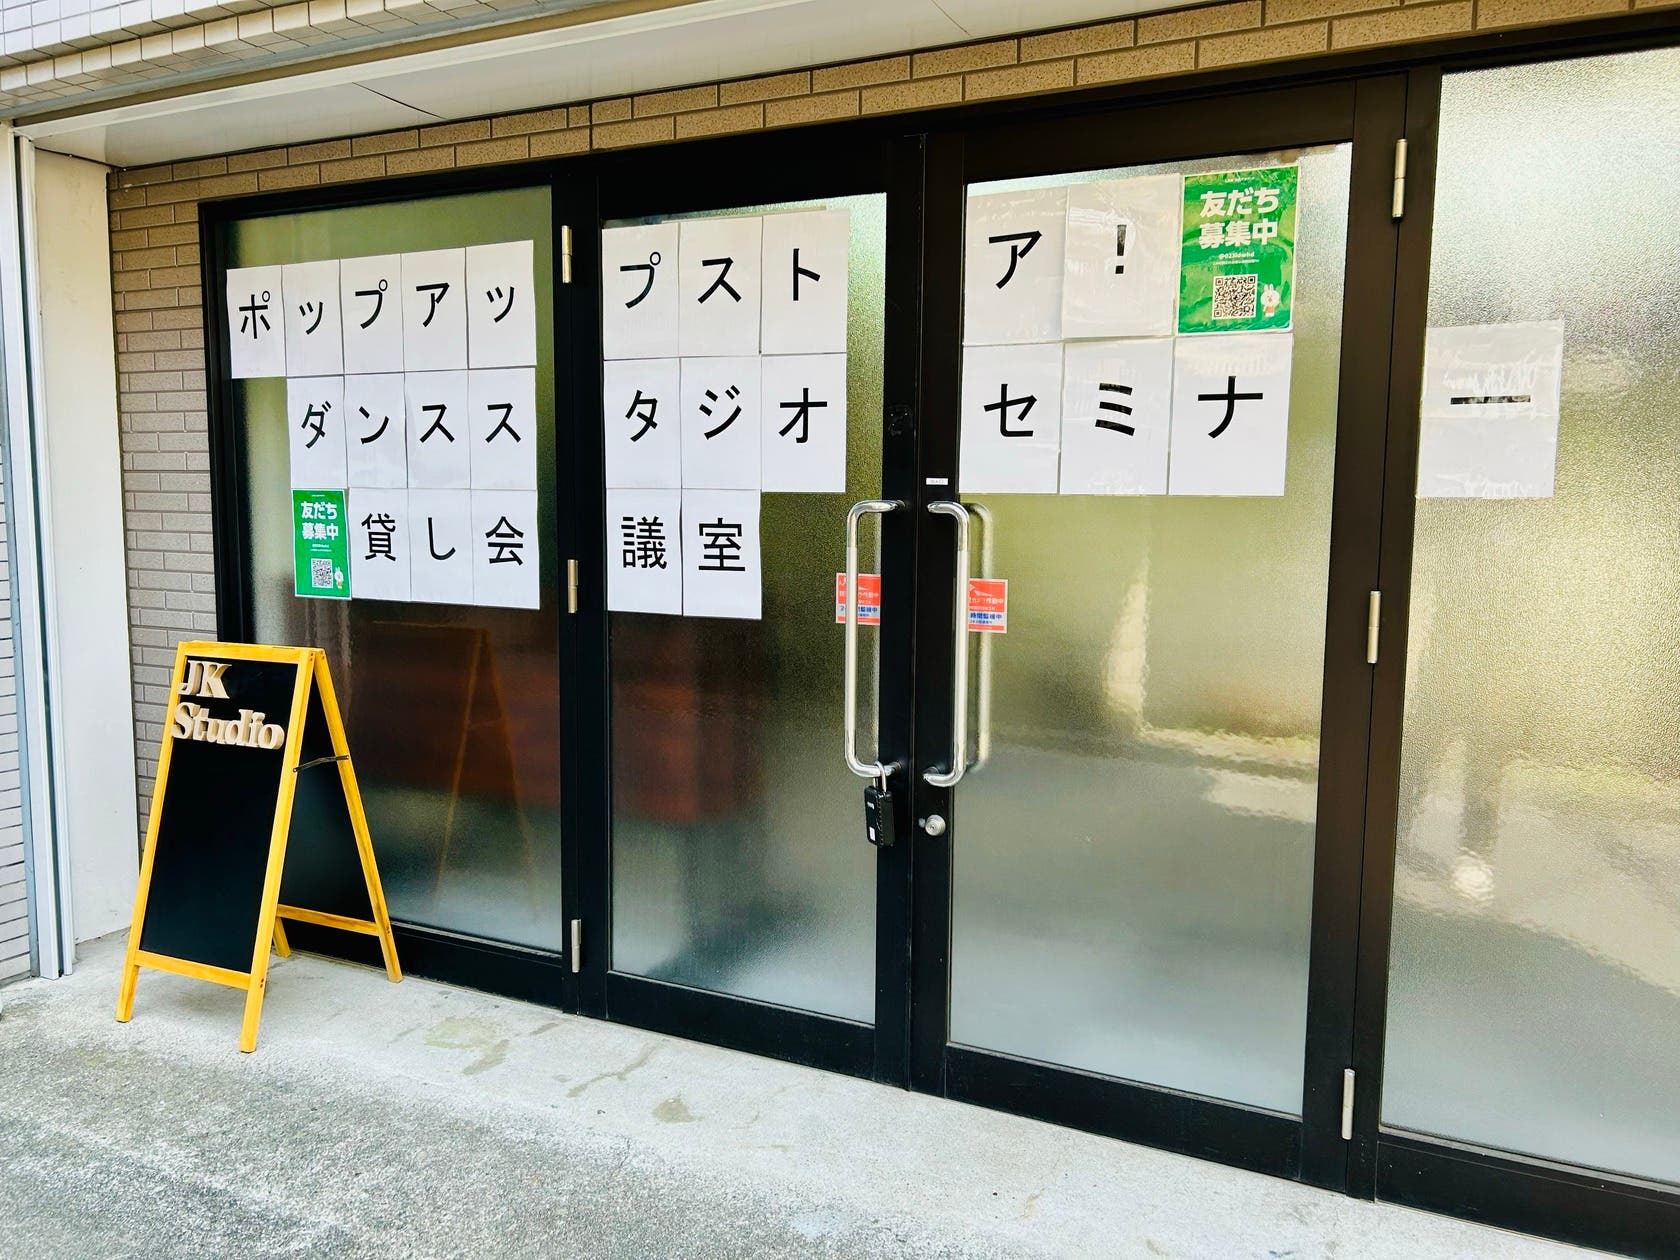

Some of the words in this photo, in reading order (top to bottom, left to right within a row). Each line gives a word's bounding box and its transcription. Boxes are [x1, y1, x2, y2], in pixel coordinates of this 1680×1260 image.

[1200, 187, 1280, 217] 友だち
[1199, 218, 1278, 249] 募集中
[301, 501, 338, 520] 友だち
[302, 522, 340, 540] 募集中
[178, 660, 232, 699] JK
[172, 702, 285, 750] Studio
